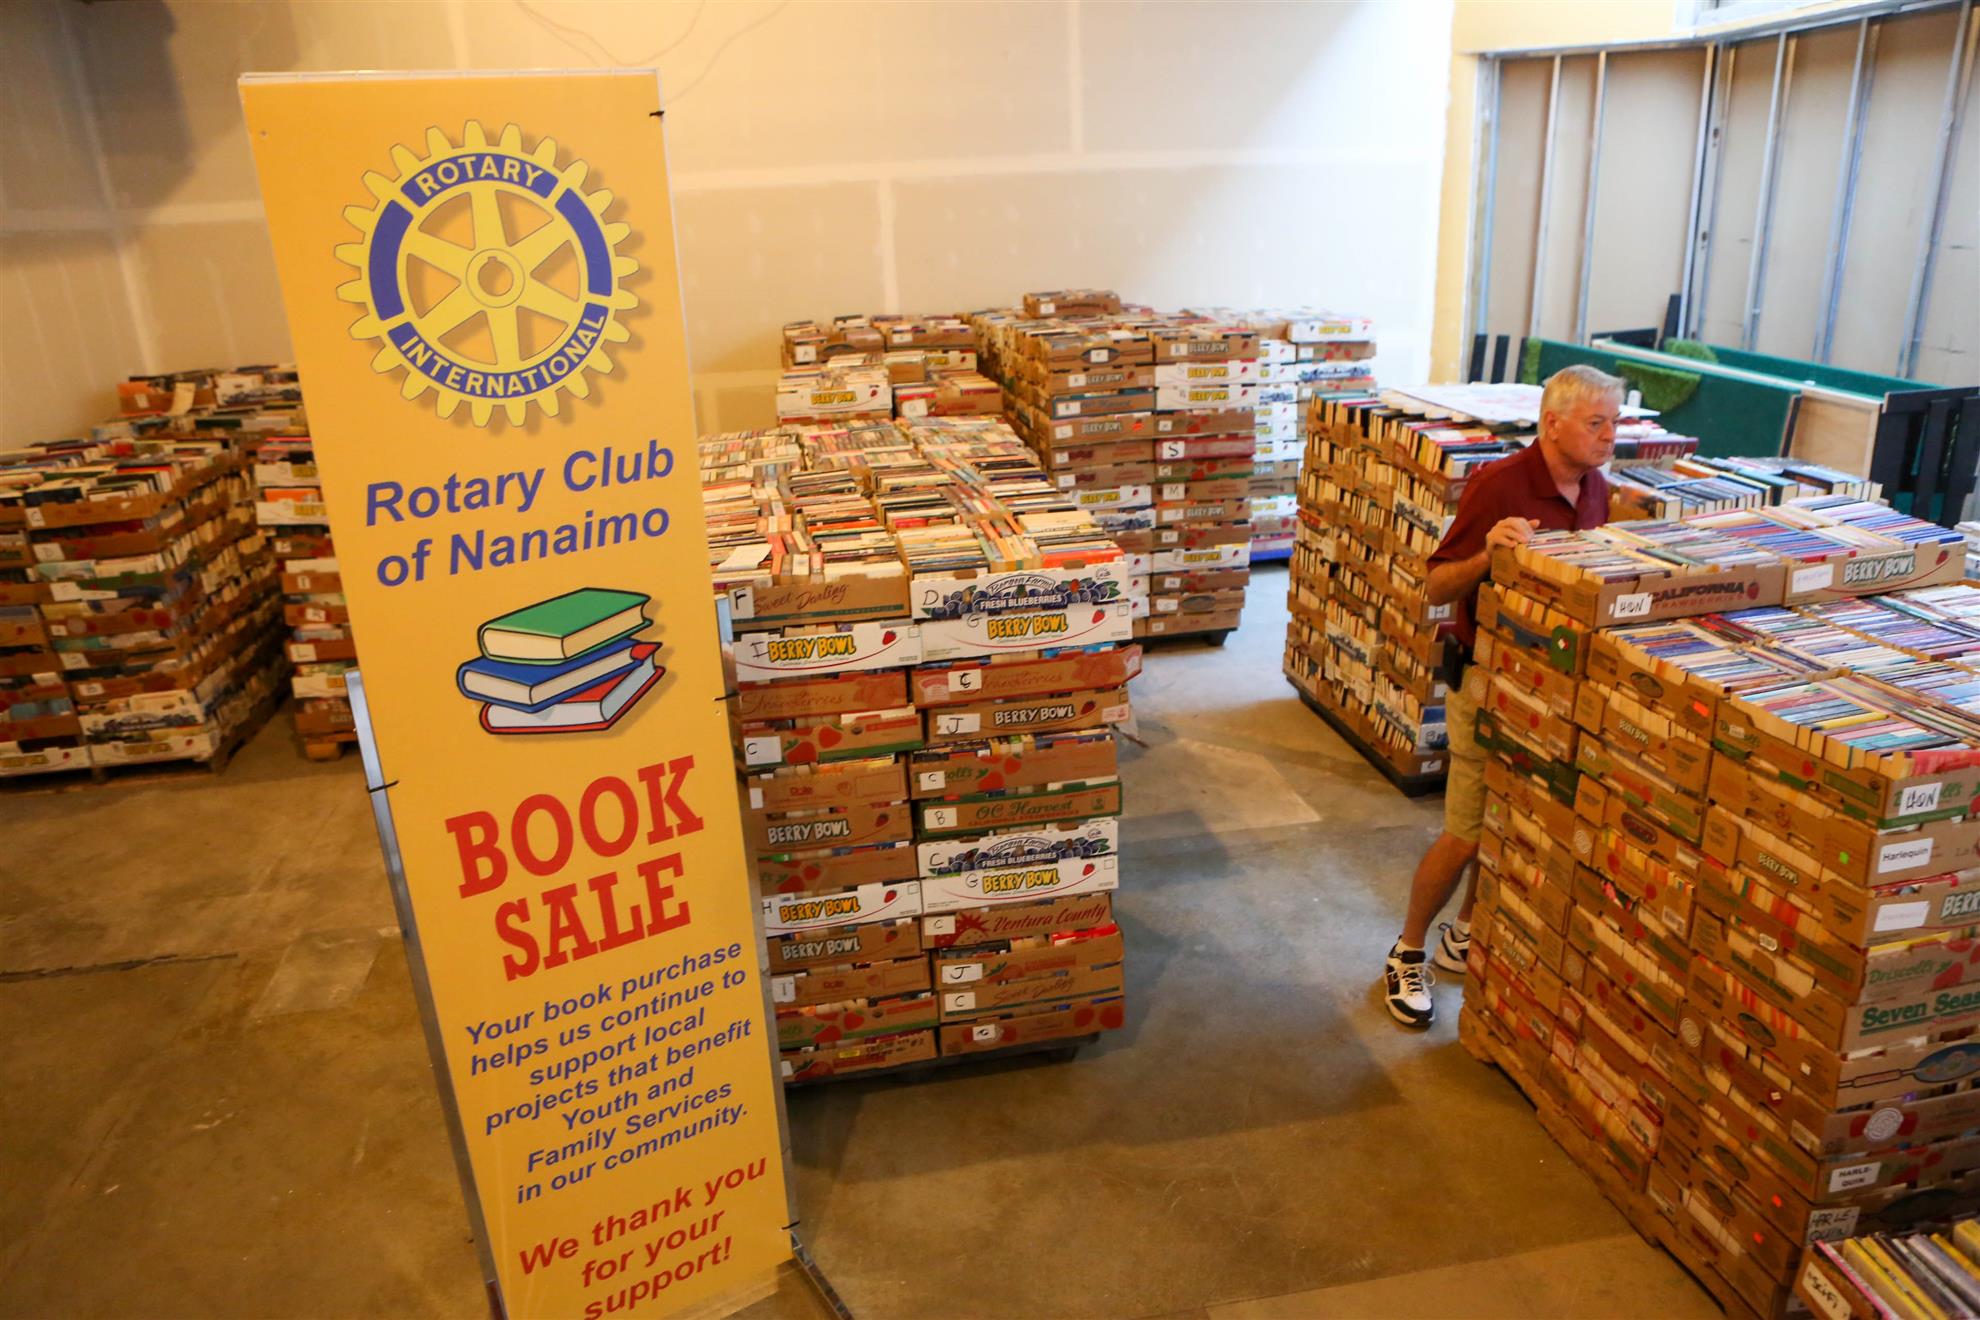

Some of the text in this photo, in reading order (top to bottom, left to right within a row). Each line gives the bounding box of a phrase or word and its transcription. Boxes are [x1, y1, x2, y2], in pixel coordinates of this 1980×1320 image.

[415, 156, 543, 197] ROTARY
[400, 315, 607, 398] INTERNATIONAL
[1168, 445, 1179, 457] S
[366, 440, 675, 526] Rotary Club
[377, 507, 670, 586] of Nanaimo
[1844, 559, 1884, 584] BERRY
[1884, 554, 1915, 578] BOWL
[734, 588, 747, 610] F
[923, 589, 939, 606] D
[980, 594, 1062, 610] FRESH BLUEBERRIES
[1652, 594, 1744, 609] TRAWBERRIES
[967, 612, 982, 627] G
[987, 613, 1069, 640] BERRY BOWL
[768, 638, 815, 663] BERRY
[816, 635, 857, 658] BOWL
[947, 717, 964, 734] J
[993, 704, 1075, 727] BERRY BOWL
[746, 742, 757, 755] C
[928, 774, 937, 782] C
[934, 810, 945, 826] B
[975, 799, 1074, 821] OC Harvest
[445, 755, 704, 899] BOOK
[768, 820, 851, 845] BERRY BOWL
[930, 852, 944, 867] C
[982, 852, 1057, 868] FRESH BLUEBERRIES
[966, 873, 979, 888] G
[982, 868, 1061, 894] BERRY BOWL
[495, 852, 691, 981] SALE
[779, 896, 861, 923] BERRY BOWL
[992, 904, 1108, 932] Ventura County
[933, 919, 943, 929] C
[782, 937, 861, 960] BERRY BOWL
[950, 966, 971, 980] J
[465, 942, 742, 1045] Your book purchase
[954, 995, 965, 1008] C
[471, 969, 746, 1076] helps us continue to
[1862, 1002, 1928, 1028] Seven
[529, 1007, 705, 1085] support local
[486, 1019, 751, 1136] projects that benefit
[562, 1067, 694, 1130] Youth and
[527, 1082, 732, 1173] Family Services
[517, 1102, 748, 1204] in our community.
[519, 1157, 767, 1276] We thank you
[581, 1210, 725, 1288] for your
[584, 1236, 732, 1320] support!
